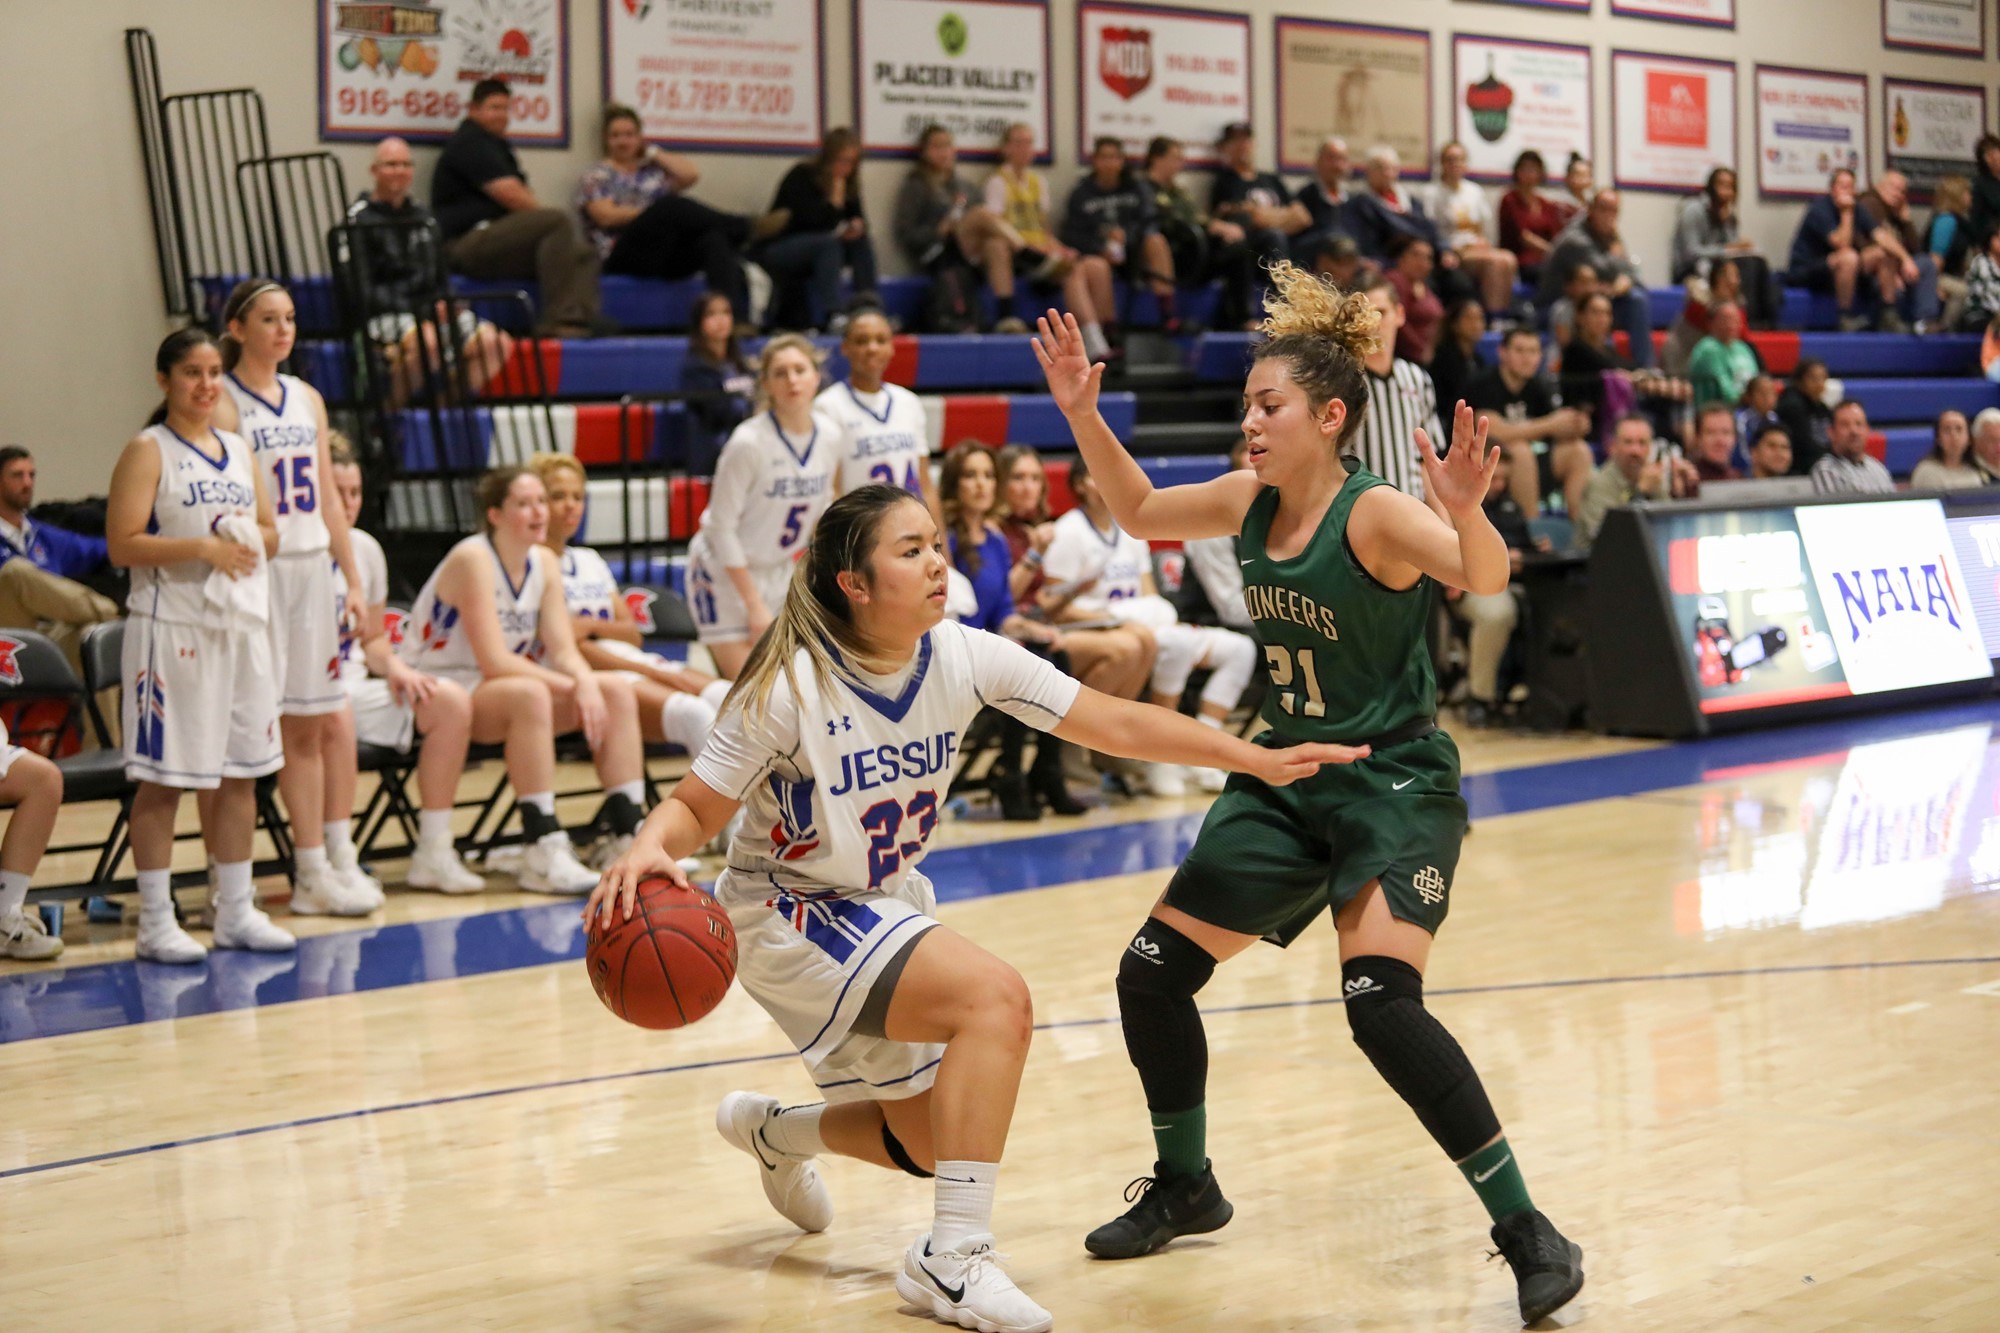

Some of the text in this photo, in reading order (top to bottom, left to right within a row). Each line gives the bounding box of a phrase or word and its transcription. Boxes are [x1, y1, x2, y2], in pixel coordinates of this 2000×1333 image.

[874, 61, 1036, 92] PLACER VALLEY
[252, 424, 318, 453] JESSU
[182, 481, 255, 508] JESSU
[272, 455, 318, 516] 15
[779, 503, 809, 549] 5
[1244, 585, 1340, 641] ONEERS
[1832, 563, 1961, 643] NAIA
[1263, 644, 1326, 718] 21
[859, 787, 940, 891] 23
